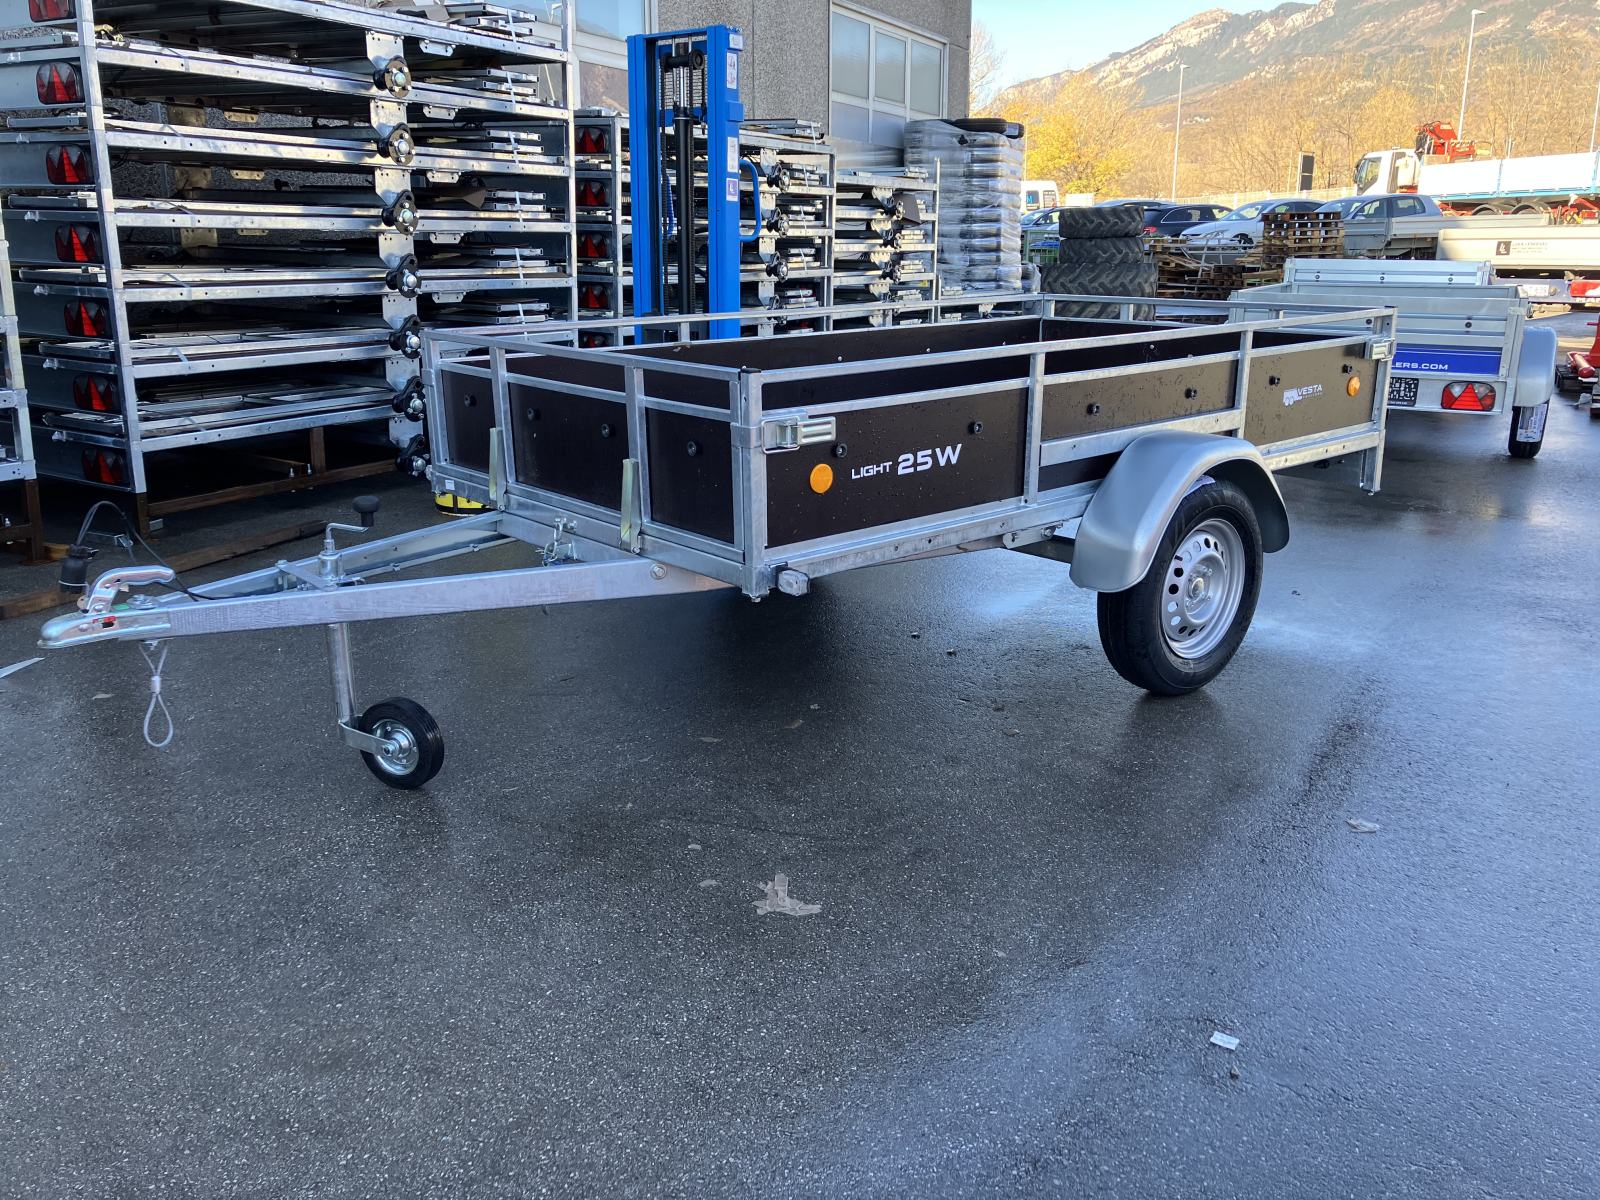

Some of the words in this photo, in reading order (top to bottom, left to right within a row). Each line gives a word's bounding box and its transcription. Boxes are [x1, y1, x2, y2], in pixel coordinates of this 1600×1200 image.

[1298, 384, 1323, 396] VESTA
[851, 461, 893, 479] LIGHT
[897, 443, 963, 475] 25W
